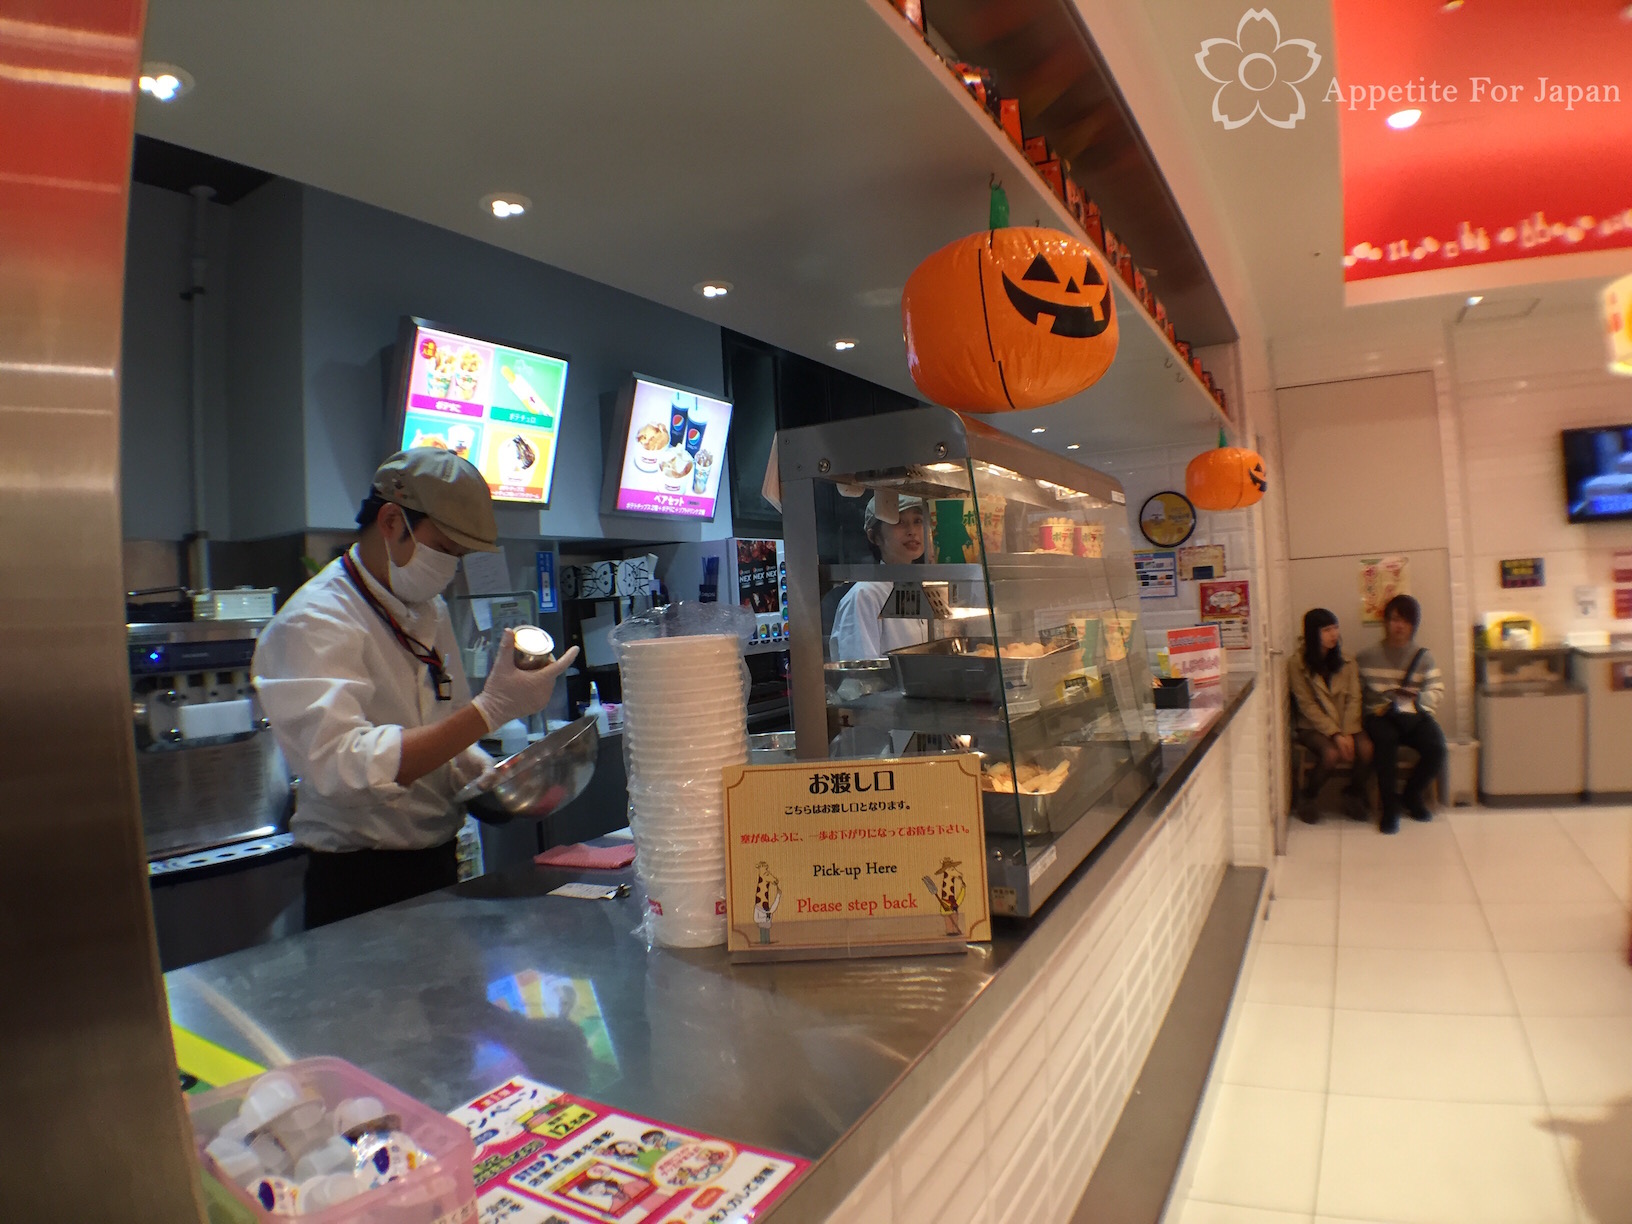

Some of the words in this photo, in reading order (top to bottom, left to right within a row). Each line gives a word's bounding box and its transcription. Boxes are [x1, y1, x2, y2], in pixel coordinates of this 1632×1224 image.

[653, 495, 685, 506] ペアセット
[740, 574, 752, 583] NEX
[753, 572, 765, 581] NEX
[766, 569, 777, 579] NEX
[809, 770, 895, 794] お渡し口
[784, 800, 911, 815] こちらはお渡し口となります。
[813, 863, 861, 880] Pick-up
[866, 862, 898, 874] Here
[797, 897, 843, 913] Please
[848, 900, 878, 916] step
[883, 893, 918, 910] back
